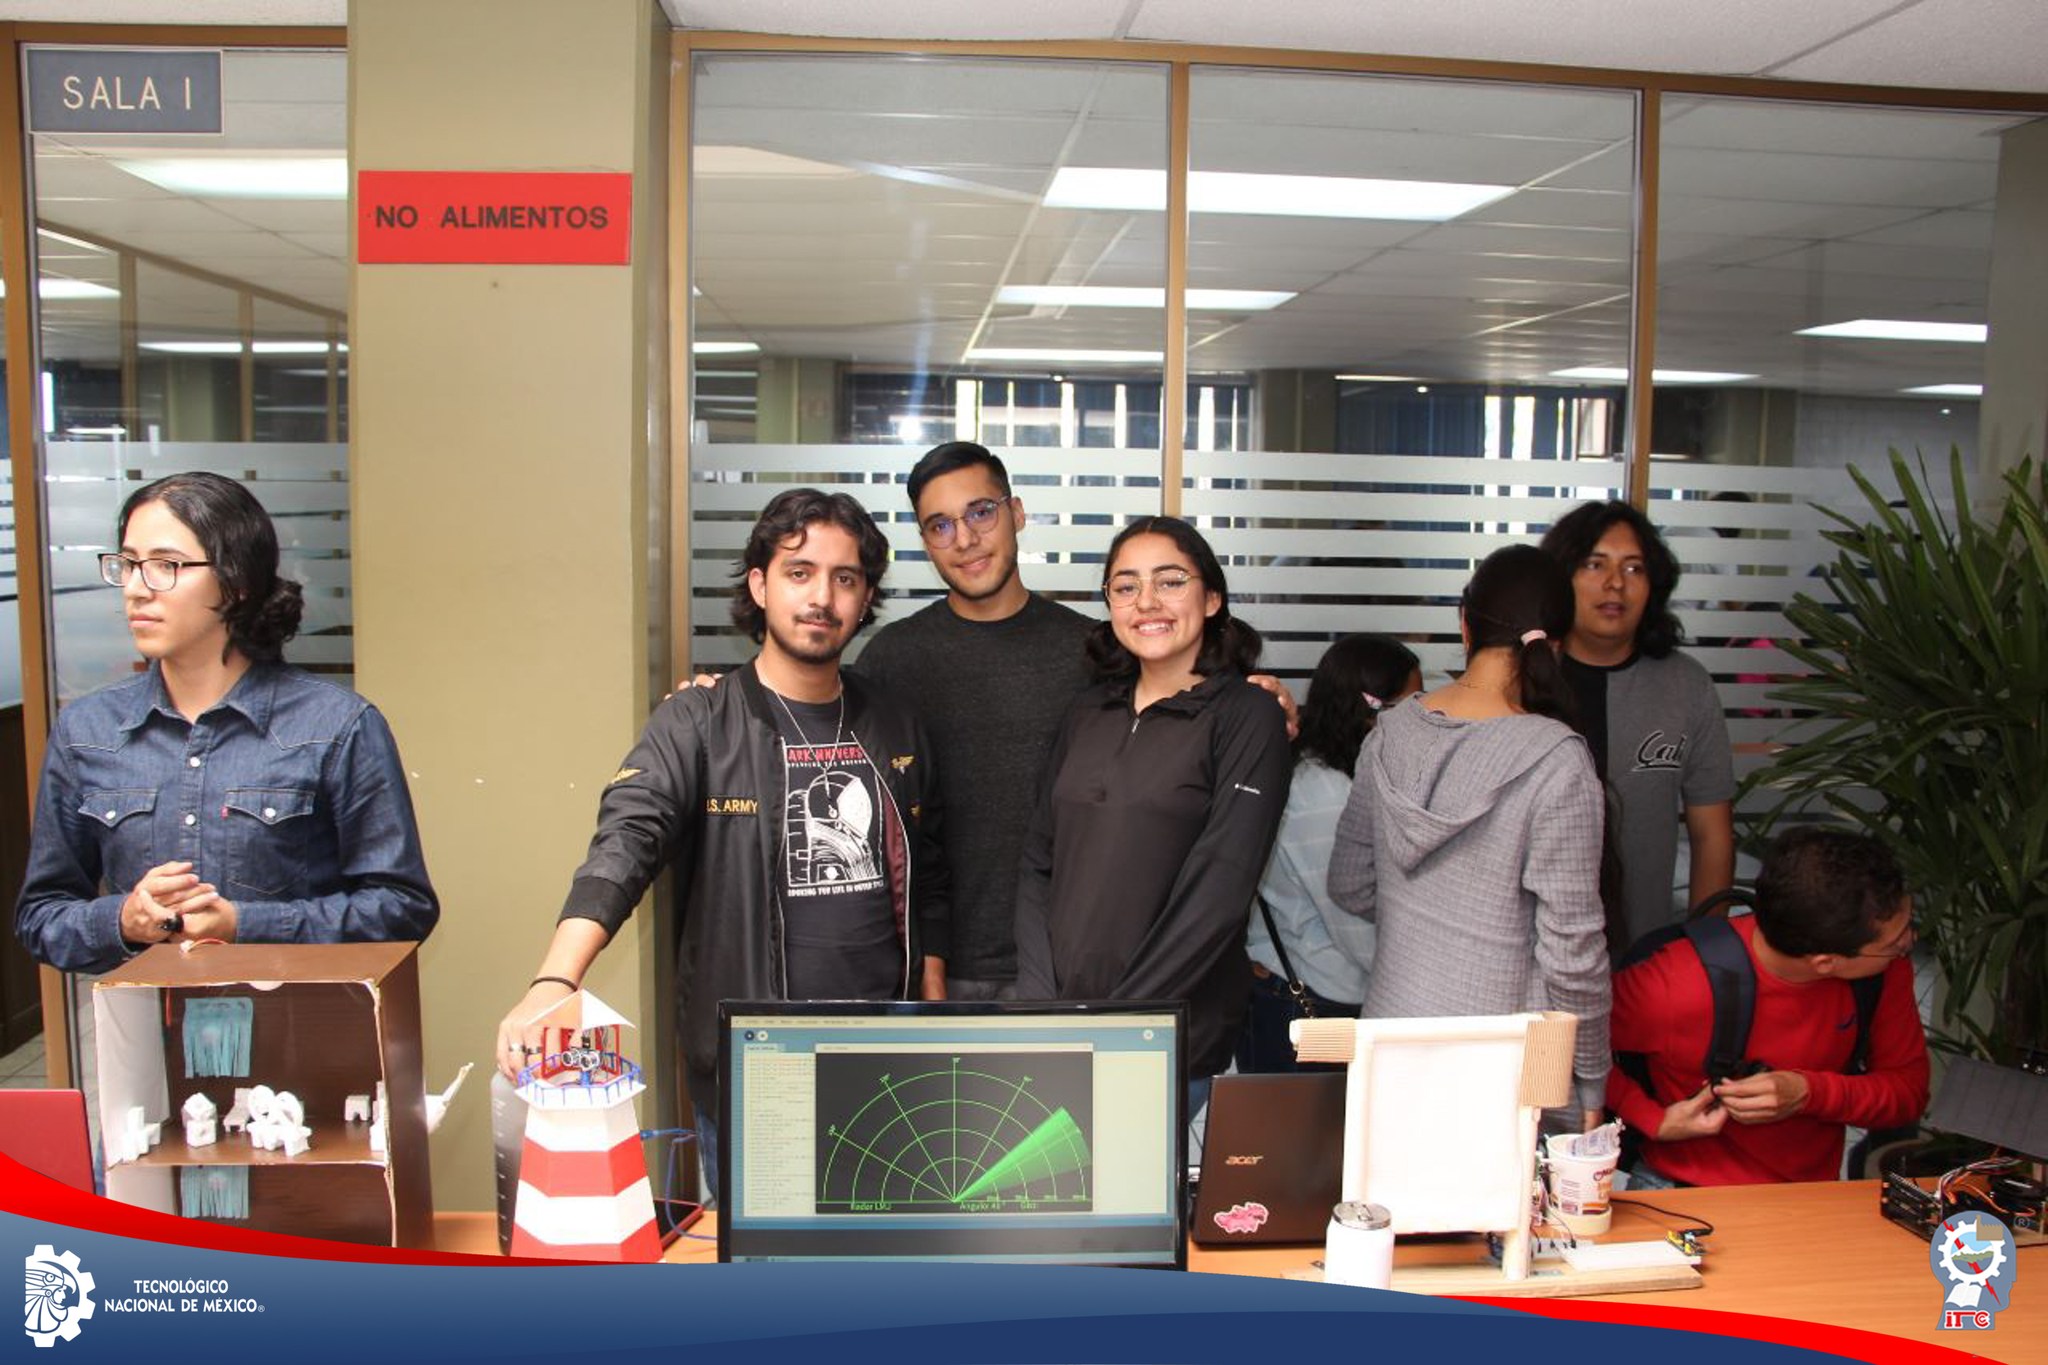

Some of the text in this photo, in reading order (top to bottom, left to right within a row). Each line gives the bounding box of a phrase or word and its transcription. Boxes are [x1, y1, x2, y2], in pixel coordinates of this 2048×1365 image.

[63, 76, 161, 110] SALA
[375, 205, 609, 230] NO ALIMENTOS
[788, 748, 811, 762] ARK
[723, 799, 758, 814] ARMY
[1225, 1155, 1264, 1166] acer
